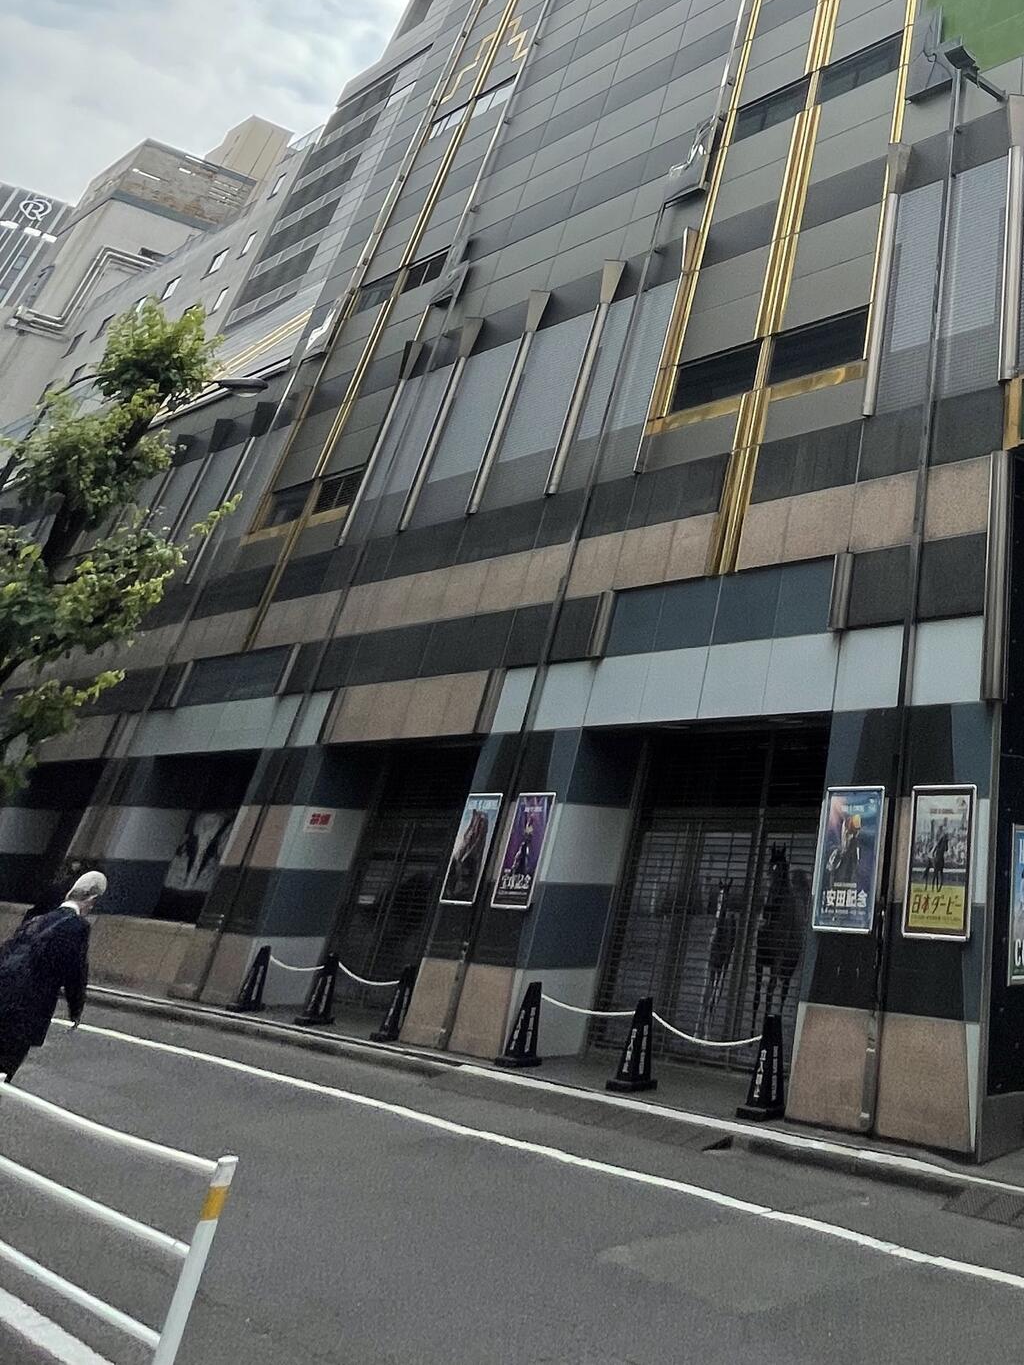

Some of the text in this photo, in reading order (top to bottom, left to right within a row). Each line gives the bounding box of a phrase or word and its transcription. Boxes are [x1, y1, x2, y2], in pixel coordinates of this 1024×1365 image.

[911, 893, 962, 916] 日本ダービー
